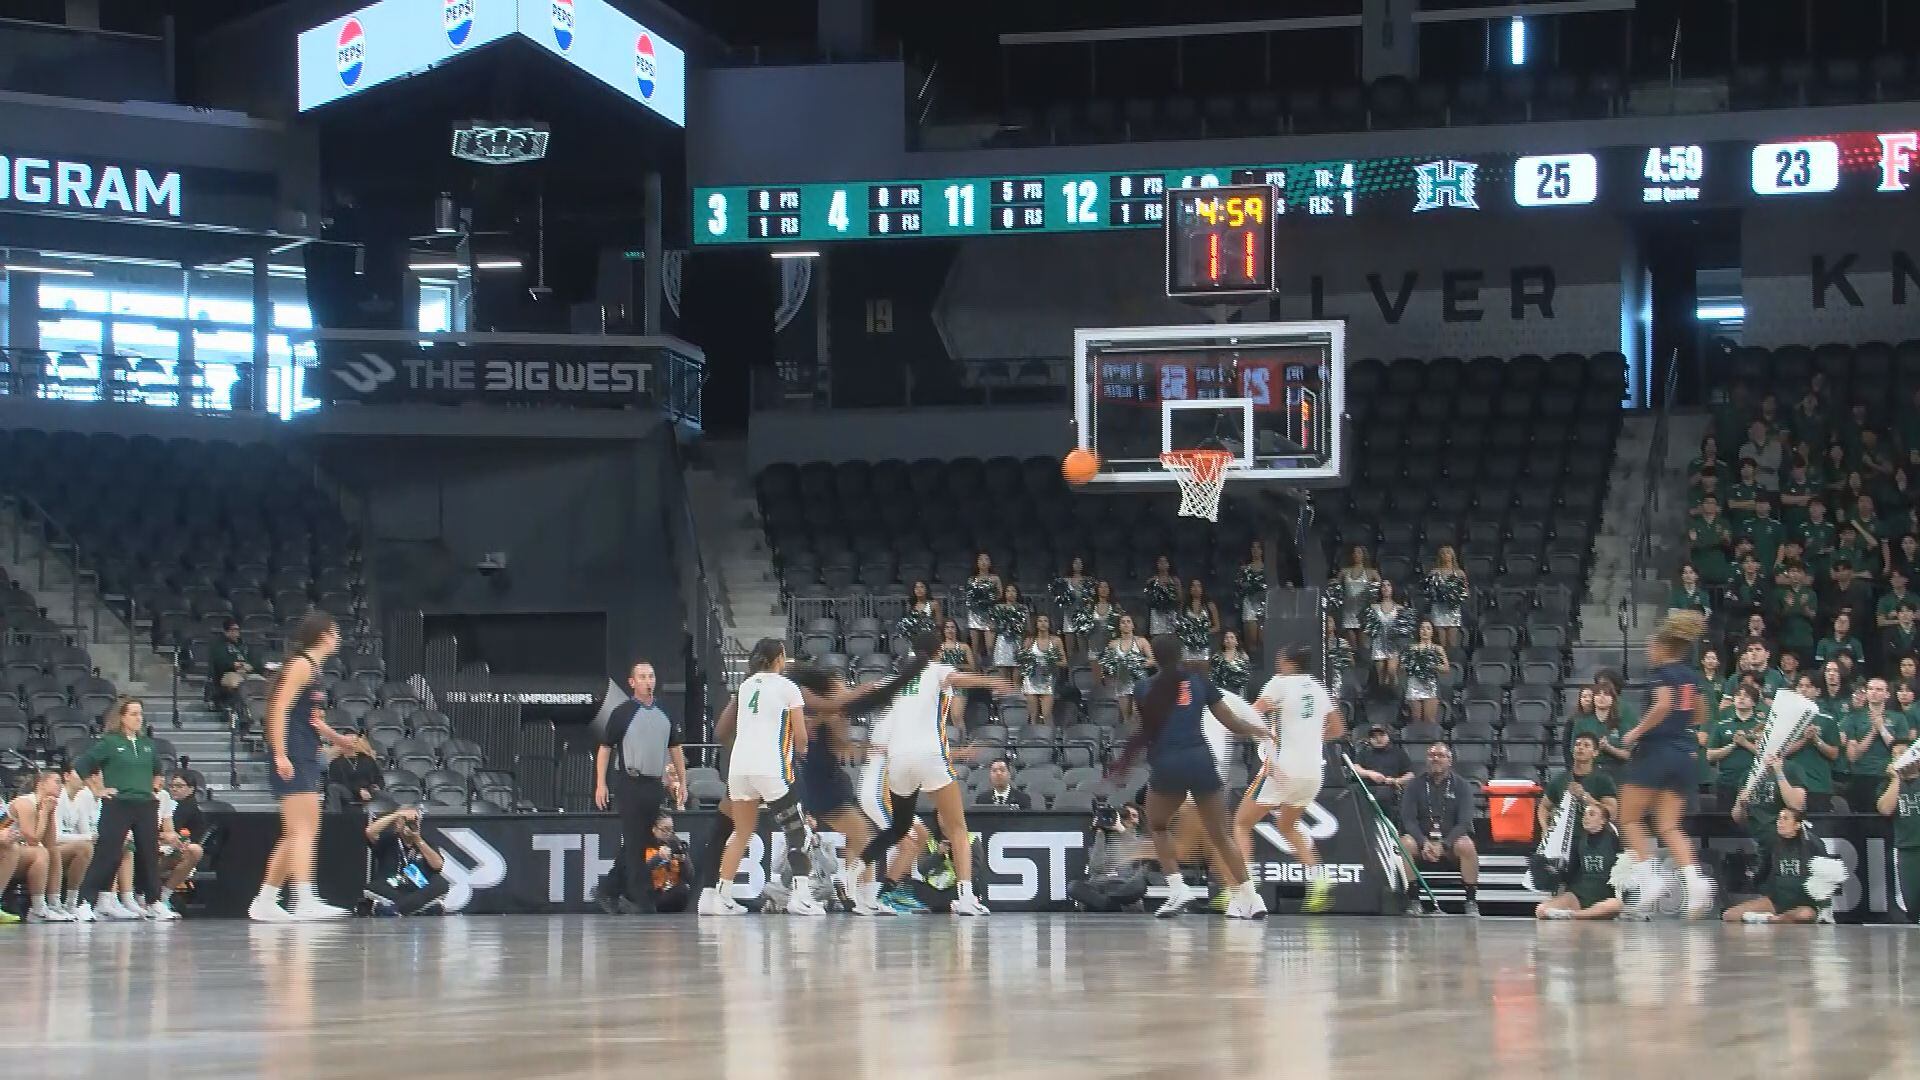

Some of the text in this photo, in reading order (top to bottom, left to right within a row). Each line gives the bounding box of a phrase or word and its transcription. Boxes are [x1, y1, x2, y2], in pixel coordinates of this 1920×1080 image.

[445, 0, 473, 21] PEPSI
[551, 3, 574, 29] PEPSI
[338, 43, 365, 64] PEPSI
[636, 55, 656, 78] PEPSI
[1341, 163, 1354, 188] 4
[1644, 146, 1703, 182] 4:59
[1776, 150, 1810, 188] 23
[1002, 181, 1013, 202] 5
[1536, 161, 1571, 199] 25
[708, 193, 727, 235] 3
[828, 190, 849, 232] 4
[944, 184, 974, 227] 11
[1062, 180, 1099, 224] 12
[1121, 203, 1130, 223] 1
[1198, 196, 1263, 227] 4:59
[1343, 191, 1354, 216] 1
[760, 217, 768, 236] 1
[1208, 231, 1254, 280] 11
[401, 359, 652, 393] THE BIG WEST
[748, 690, 761, 714] 4
[1264, 863, 1303, 882] BIG
